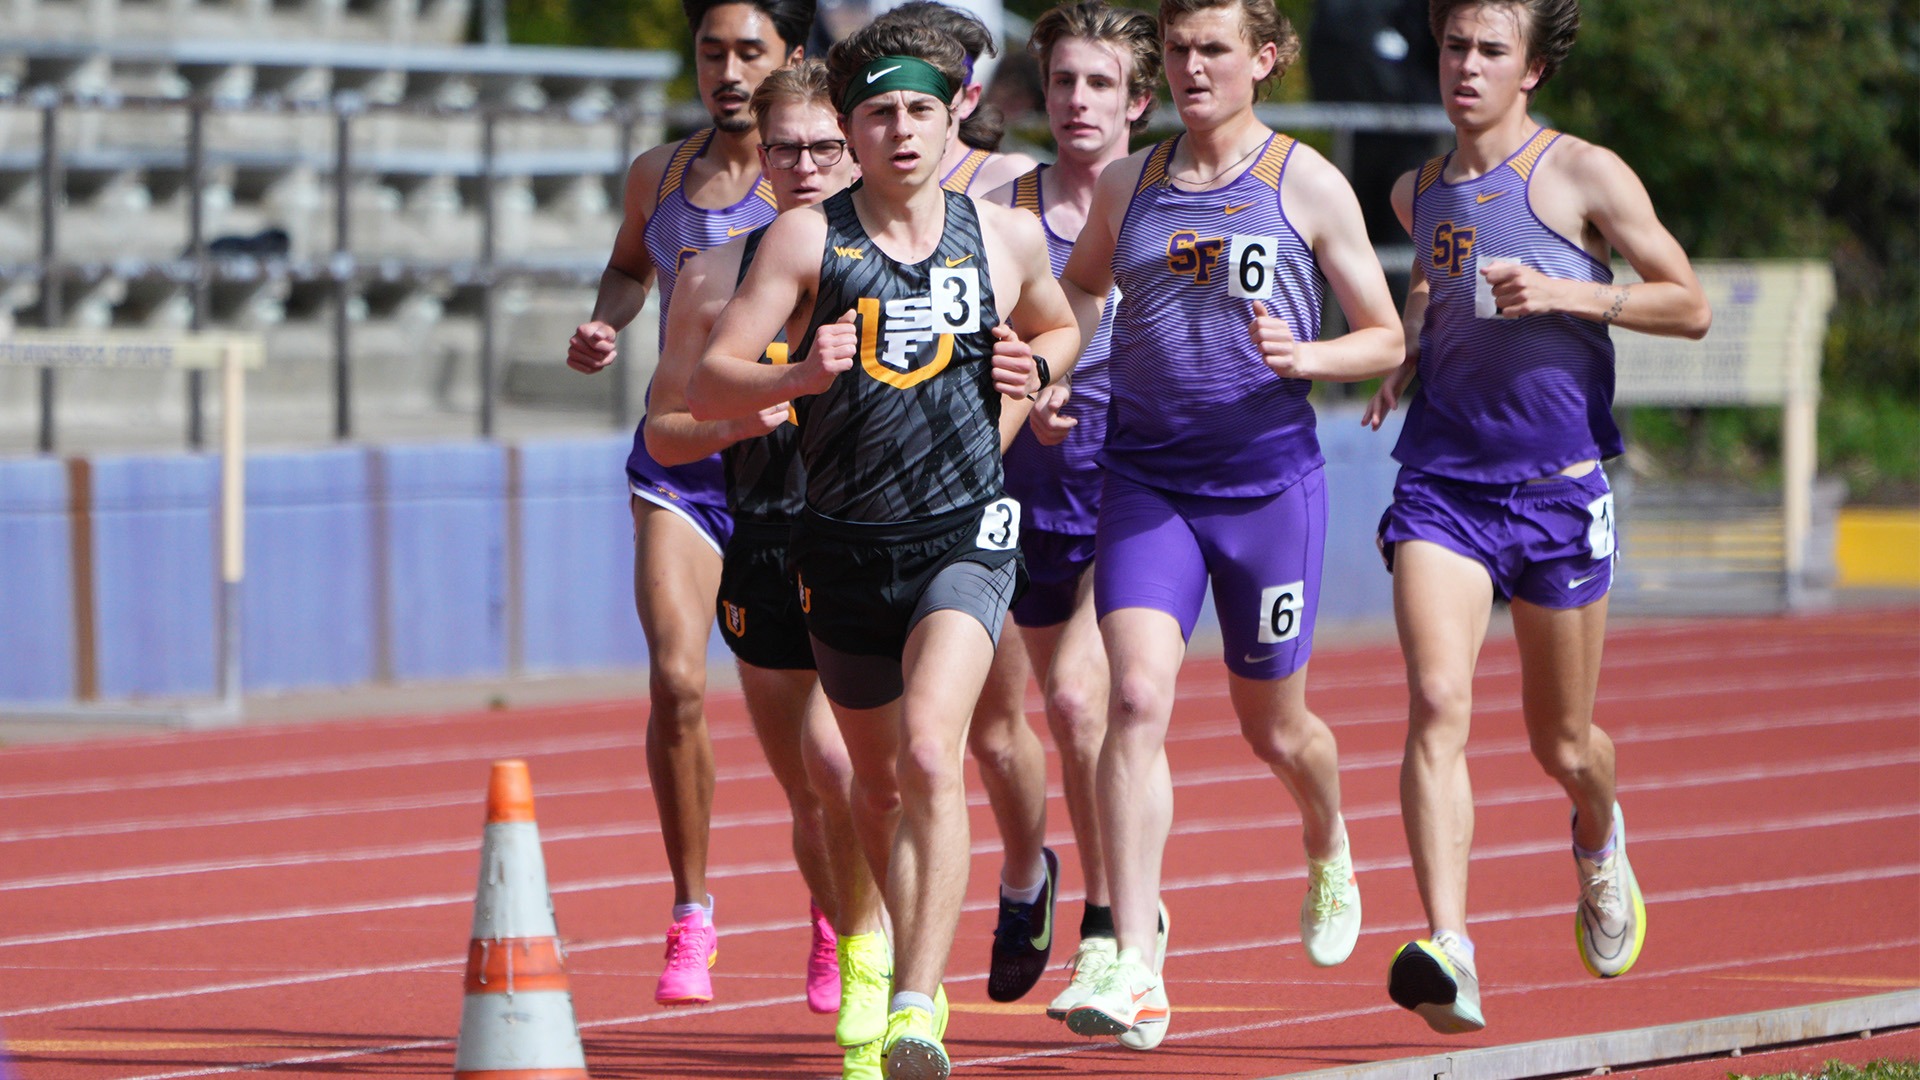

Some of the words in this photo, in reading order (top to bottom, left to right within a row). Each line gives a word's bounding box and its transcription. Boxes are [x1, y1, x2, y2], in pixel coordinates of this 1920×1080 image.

[833, 246, 864, 260] WCC
[1166, 229, 1224, 284] SF
[1239, 243, 1267, 293] 6
[1432, 220, 1477, 277] SF
[943, 276, 970, 327] 3
[988, 503, 1013, 548] 3
[1271, 592, 1294, 637] 6
